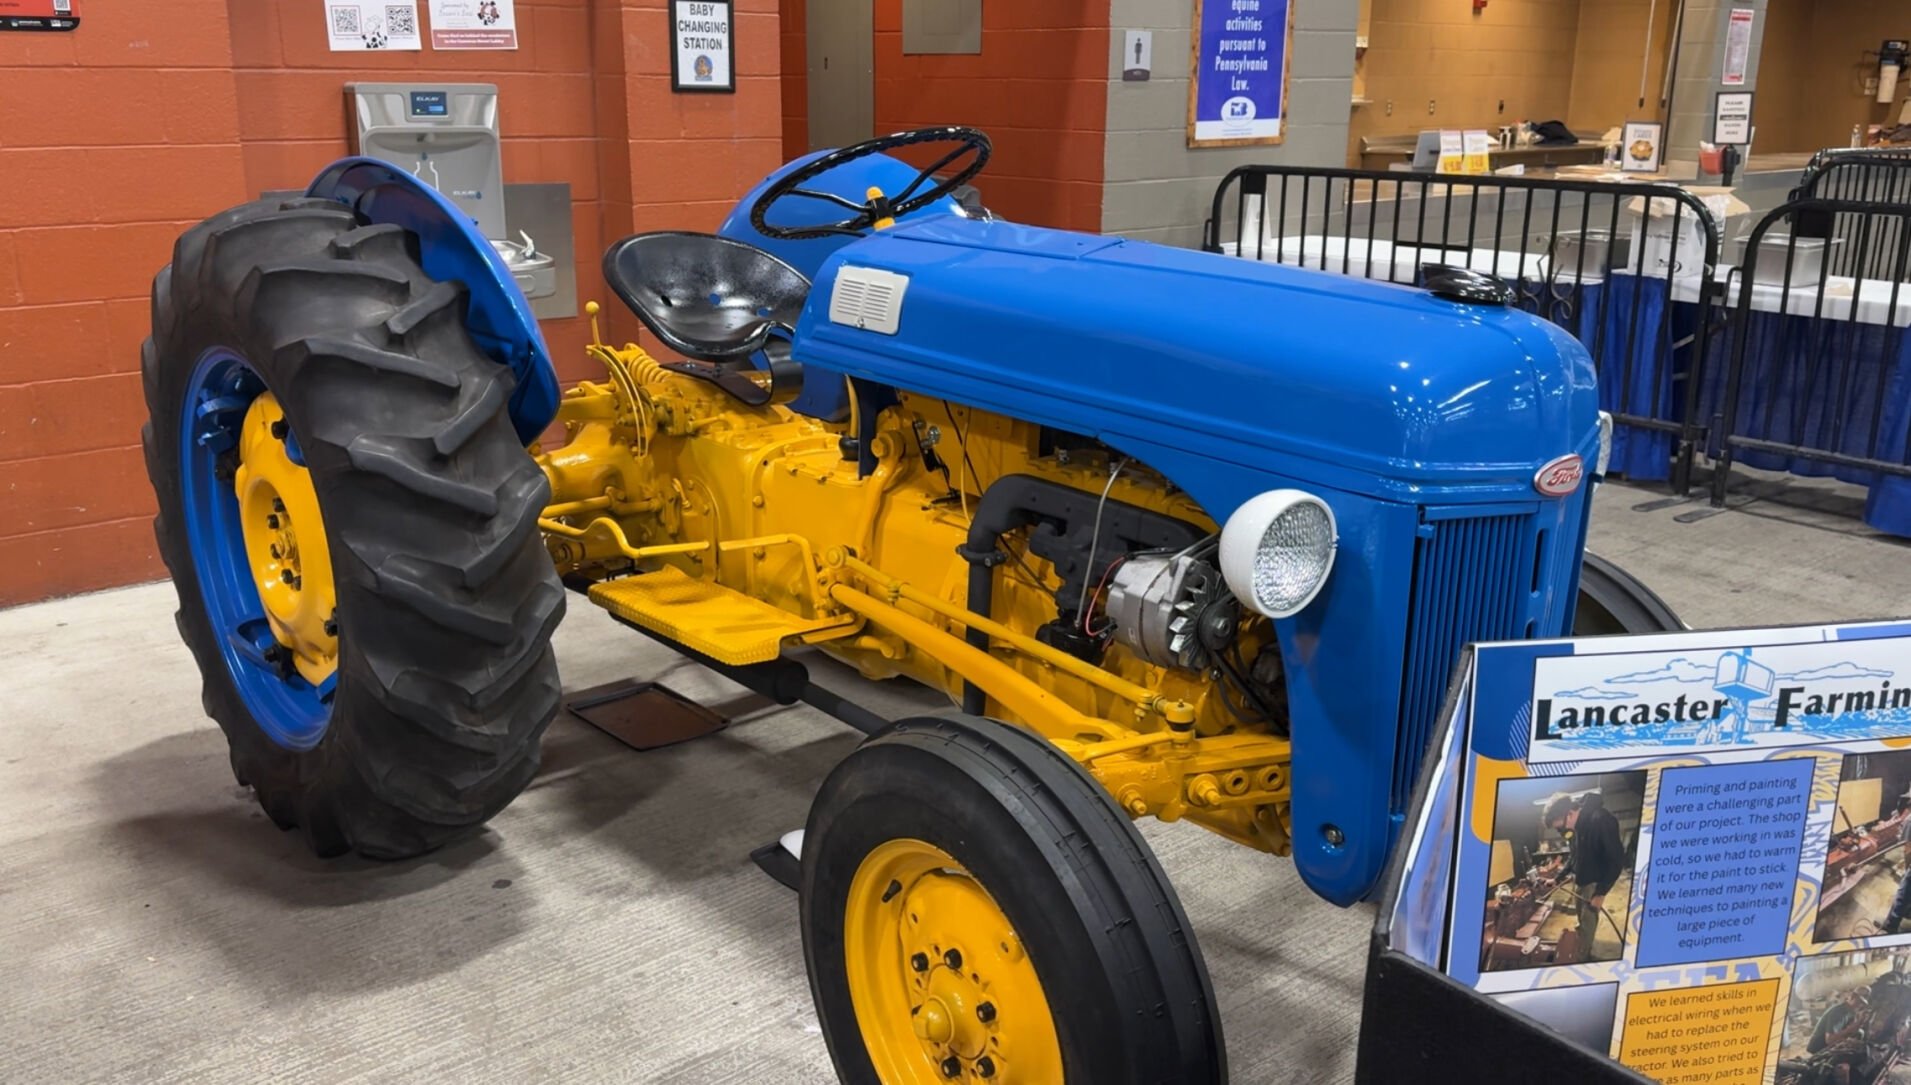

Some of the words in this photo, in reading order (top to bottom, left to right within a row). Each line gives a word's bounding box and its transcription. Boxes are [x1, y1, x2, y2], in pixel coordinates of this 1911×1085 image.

[689, 3, 715, 17] BABY
[1231, 0, 1260, 14] equine
[678, 20, 727, 34] CHANGING
[1225, 16, 1263, 32] activities
[683, 36, 723, 50] STATION
[1219, 38, 1256, 54] pursuant
[1258, 38, 1266, 51] to
[1215, 55, 1268, 75] Pennsylvania
[1231, 75, 1250, 91] Law.
[1546, 462, 1581, 487] Ford
[1534, 692, 1732, 742] Lancaster
[1674, 781, 1721, 796] Priming
[1723, 780, 1746, 793] and
[1749, 776, 1798, 791] painting
[1664, 802, 1694, 814] were
[1696, 802, 1704, 812] a
[1706, 795, 1774, 811] challenging
[1776, 793, 1802, 808] part
[1660, 819, 1674, 832] of
[1675, 819, 1696, 831] our
[1699, 816, 1744, 831] project.
[1749, 813, 1769, 825] The
[1772, 811, 1801, 824] shop
[1660, 838, 1678, 849] we
[1680, 836, 1709, 848] were
[1712, 830, 1758, 845] working
[1760, 829, 1771, 840] in
[1773, 828, 1796, 839] was
[1655, 854, 1684, 867] cold,
[1687, 853, 1702, 864] so
[1704, 852, 1721, 862] we
[1724, 847, 1745, 861] had
[1749, 847, 1761, 858] to
[1763, 846, 1796, 857] warm
[1656, 871, 1666, 884] it
[1668, 871, 1686, 883] for
[1689, 868, 1709, 881] the
[1710, 865, 1741, 881] paint
[1744, 864, 1757, 876] to
[1759, 862, 1790, 875] stick.
[1657, 889, 1676, 901] We
[1678, 884, 1724, 899] learned
[1726, 882, 1758, 896] many
[1760, 881, 1785, 891] new
[1648, 901, 1714, 918] techniques
[1716, 900, 1729, 912] to
[1731, 896, 1779, 912] painting
[1780, 896, 1788, 905] a
[1676, 918, 1706, 933] large
[1708, 917, 1741, 932] piece
[1742, 913, 1757, 926] of
[1678, 932, 1745, 949] equipment.
[1648, 996, 1667, 1009] We
[1669, 992, 1714, 1007] learned
[1716, 988, 1744, 1002] skills
[1746, 988, 1758, 998] in
[1628, 1010, 1683, 1027] electrical
[1685, 1007, 1720, 1021] wiring
[1722, 1001, 1753, 1017] when
[1755, 1002, 1772, 1013] we
[1646, 1027, 1669, 1041] had
[1671, 1026, 1684, 1038] to
[1685, 1021, 1729, 1040] replace
[1731, 1019, 1750, 1031] the
[1630, 1042, 1678, 1058] steering
[1679, 1039, 1721, 1057] system
[1723, 1036, 1738, 1048] on
[1740, 1034, 1760, 1045] our
[1671, 1057, 1689, 1069] We
[1691, 1052, 1715, 1066] also
[1717, 1048, 1744, 1064] tried
[1746, 1048, 1759, 1060] to
[1666, 1073, 1679, 1084] as
[1681, 1070, 1713, 1085] many
[1715, 1065, 1744, 1080] parts
[1746, 1064, 1760, 1075] as
